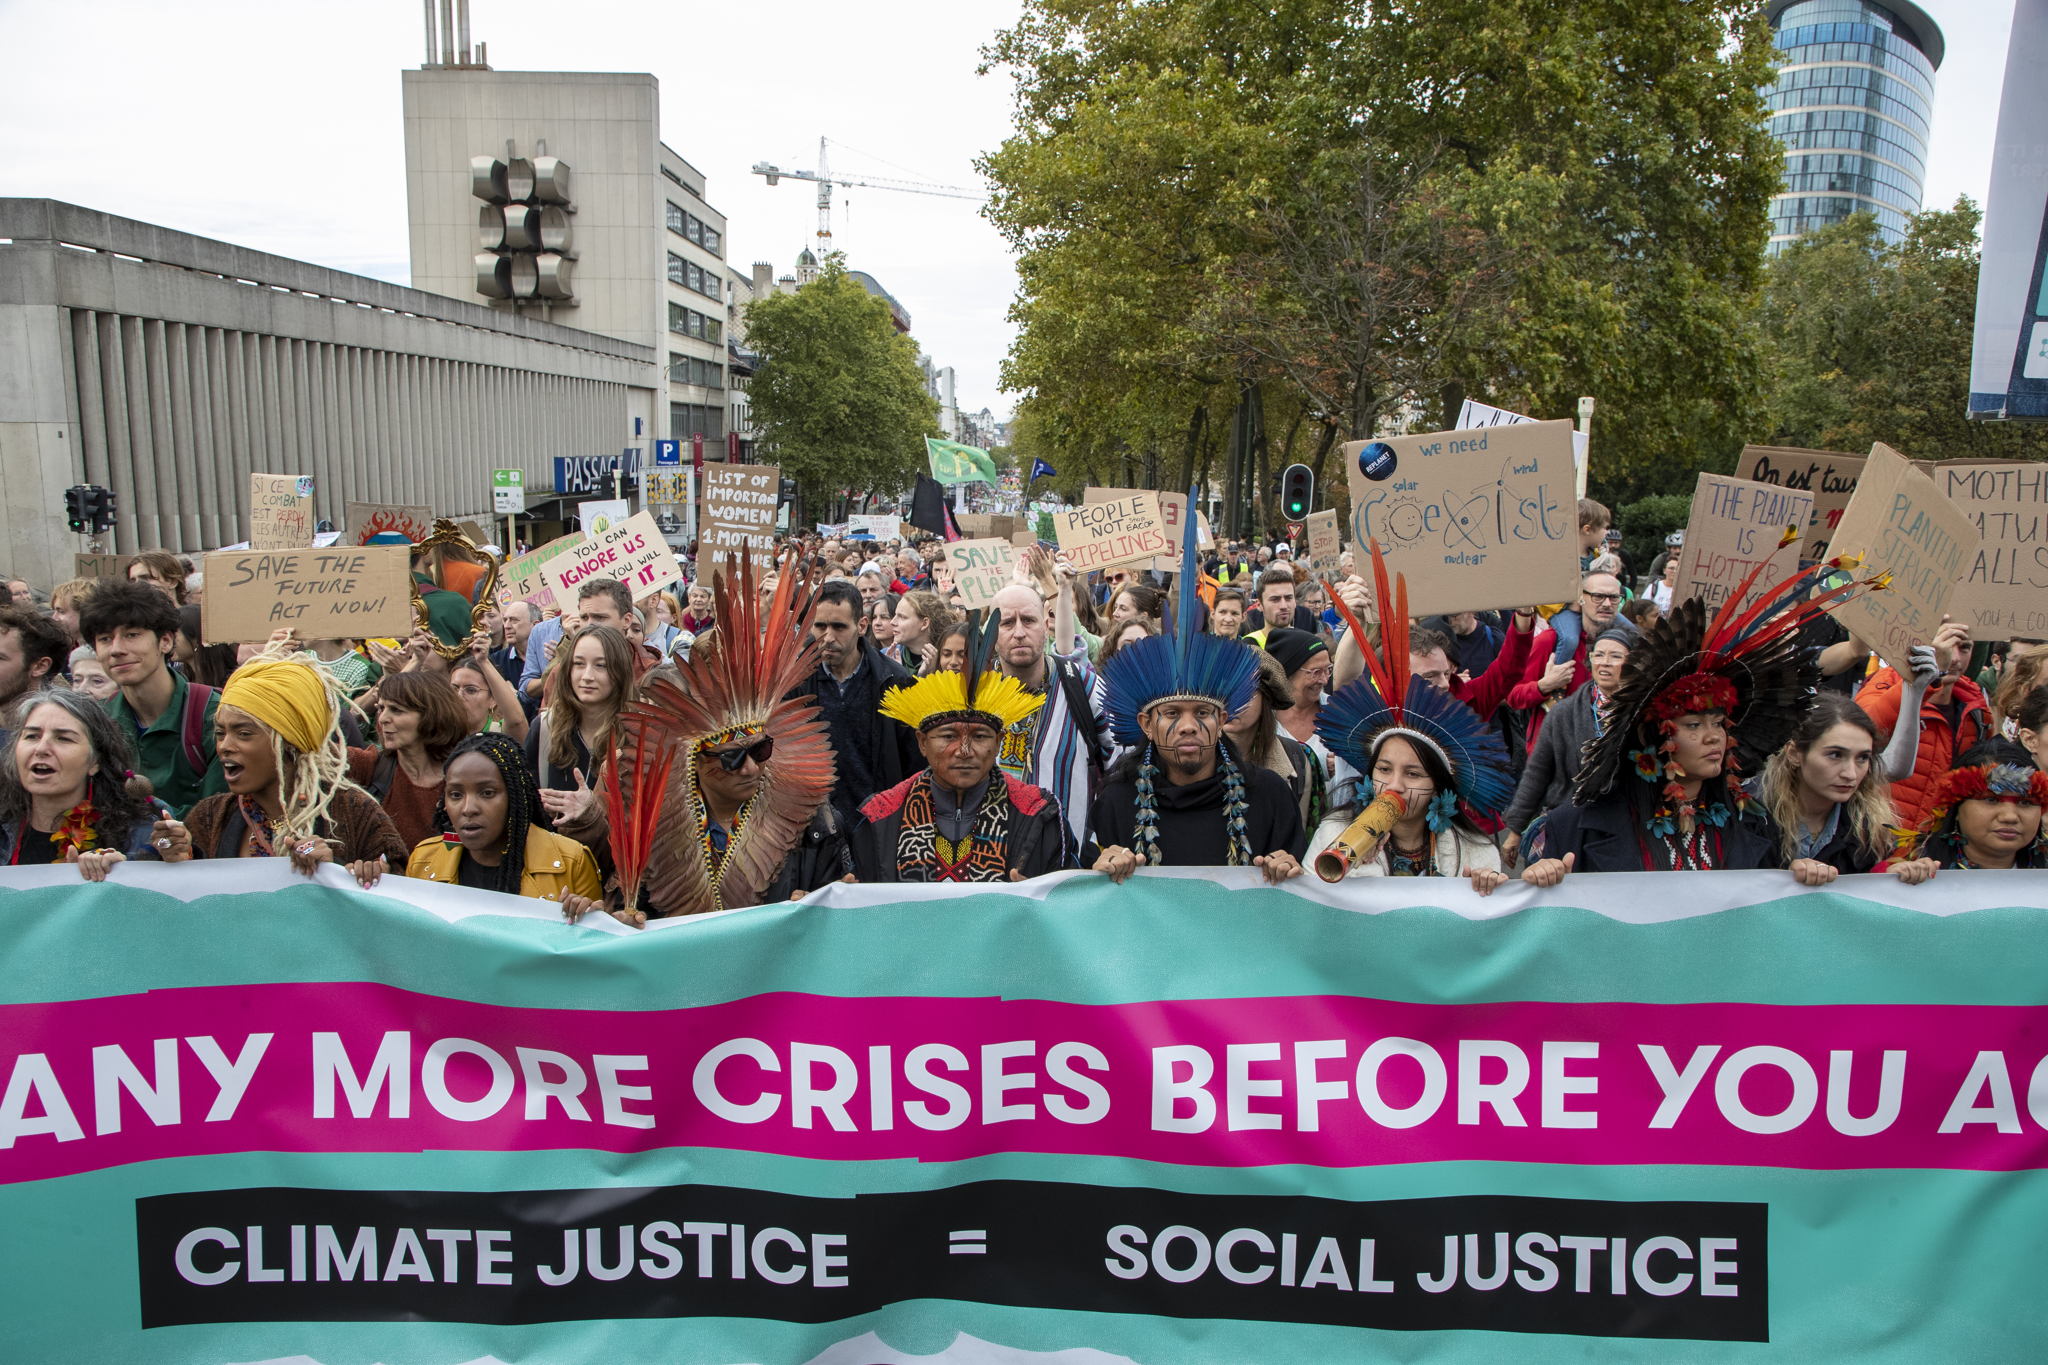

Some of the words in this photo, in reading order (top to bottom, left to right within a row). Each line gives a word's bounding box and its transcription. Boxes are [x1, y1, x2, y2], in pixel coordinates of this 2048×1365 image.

[663, 443, 673, 457] P
[1449, 432, 1488, 454] need
[1365, 451, 1390, 473] REPLANET
[1513, 458, 1538, 475] wind
[1752, 456, 1781, 486] On
[1785, 462, 1819, 490] est
[270, 479, 285, 494] CE
[750, 475, 770, 488] OF
[1392, 478, 1419, 492] solar
[1948, 469, 2048, 504] MOTH
[262, 493, 305, 507] COMBAT
[1709, 482, 1745, 521] THE
[1750, 489, 1813, 530] PLANET
[253, 508, 271, 520] EST
[707, 503, 773, 524] WOMEN
[1068, 496, 1146, 530] PEOPLE
[256, 522, 270, 536] LES
[1092, 518, 1124, 538] NOT
[1969, 511, 2048, 543] ATU
[574, 542, 599, 559] YOU
[605, 528, 629, 544] CAN
[716, 530, 774, 550] MOTHER
[1065, 528, 1166, 567] PIPELINES
[1313, 536, 1333, 549] STOP
[1736, 527, 1756, 555] IS
[559, 548, 618, 589] IGNORE
[622, 533, 646, 554] US
[608, 562, 633, 580] YOU
[637, 550, 662, 566] WILL
[952, 545, 1013, 571] SAVE
[1444, 551, 1487, 565] nuclear
[1693, 548, 1780, 587] HOTTER
[1958, 548, 2048, 588] ALLS
[229, 555, 300, 587] SAVE
[314, 555, 366, 574] THE
[274, 579, 358, 596] FUTURE
[518, 579, 531, 595] IS
[269, 601, 310, 622] ACT
[329, 596, 387, 615] NOW!
[1972, 608, 2001, 628] YOU
[2007, 611, 2017, 630] A
[2026, 611, 2048, 631] CO
[313, 1031, 656, 1128] MORE
[693, 1038, 1111, 1131] CRISES
[1152, 1037, 1600, 1133] BEFORE
[1638, 1045, 1907, 1136] YOU
[1937, 1051, 2048, 1134] A
[175, 1225, 513, 1285] CLIMATE
[537, 1221, 849, 1288] JUSTICE
[1105, 1225, 1395, 1293] SOCIAL
[1417, 1233, 1738, 1297] JUSTICE
